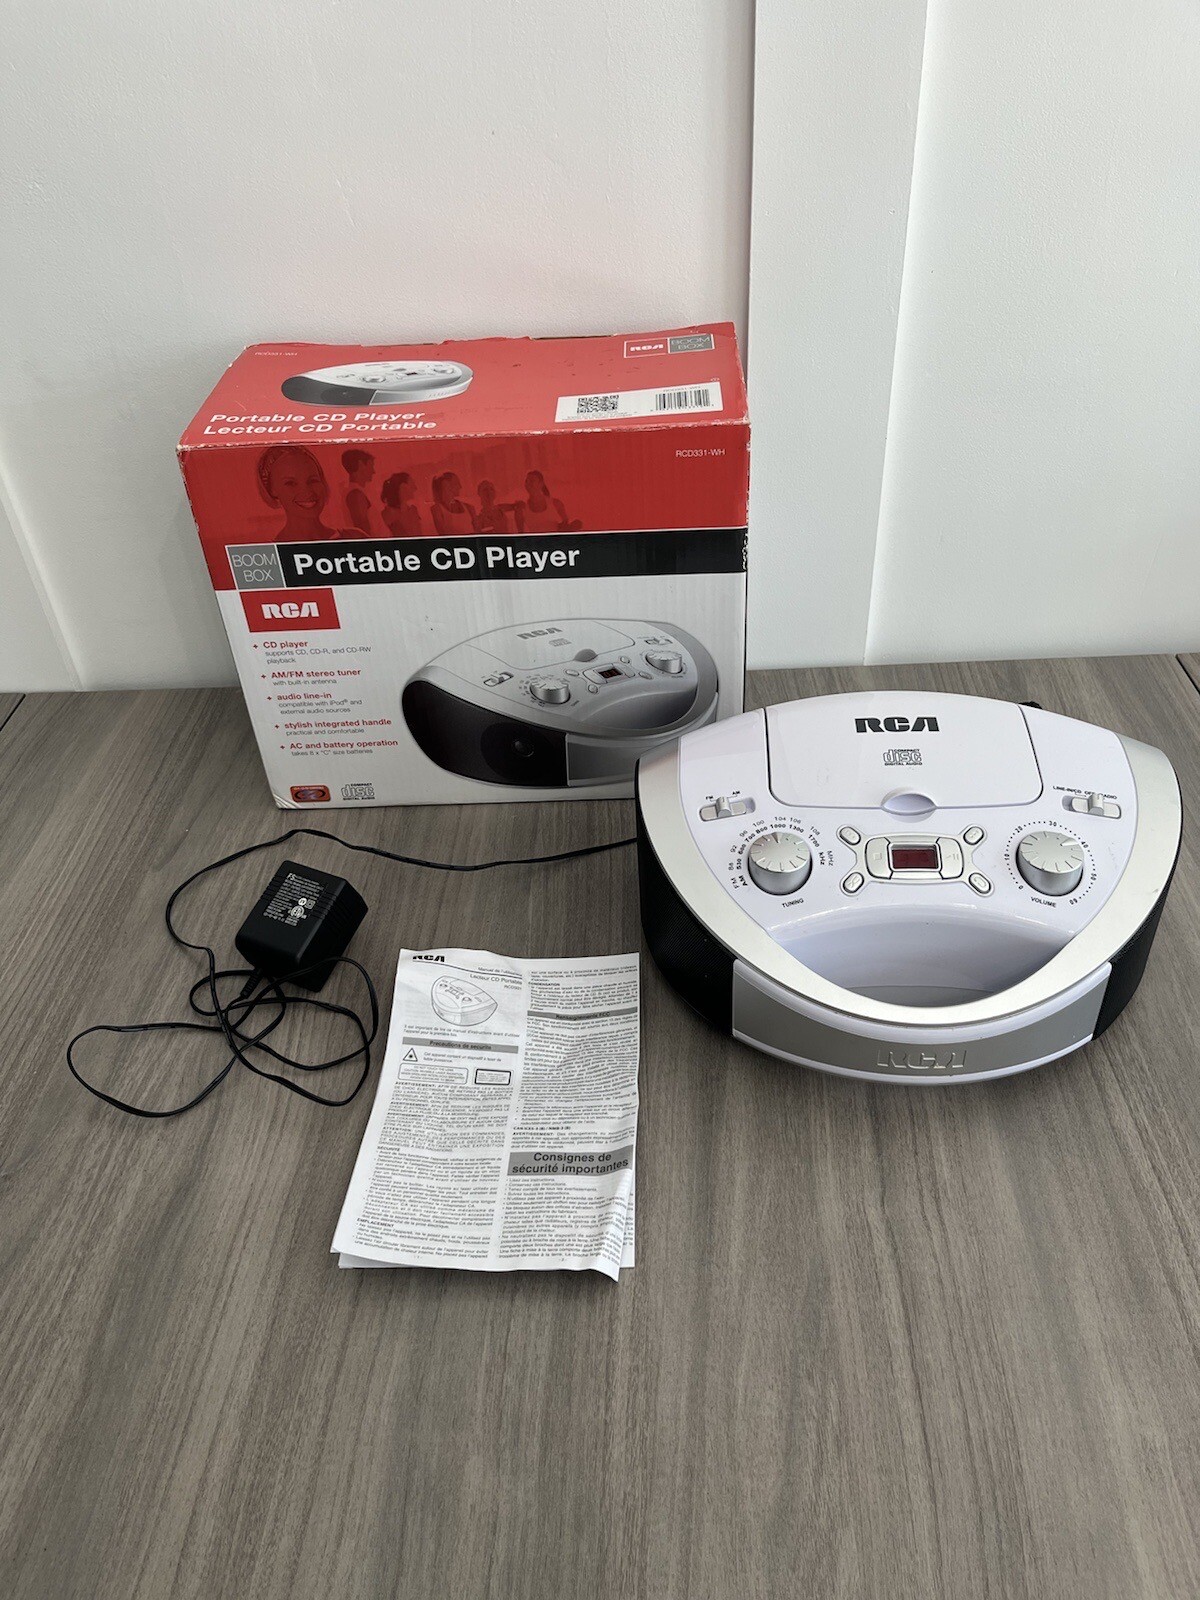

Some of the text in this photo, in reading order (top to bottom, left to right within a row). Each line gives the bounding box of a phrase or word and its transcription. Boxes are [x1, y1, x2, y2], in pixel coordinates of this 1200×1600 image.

[671, 336, 711, 345] BOOM
[210, 412, 426, 423] Portable CD Player
[203, 420, 437, 434] Lecteur CD Portable
[676, 448, 726, 458] RCD331-WH
[232, 552, 277, 568] BOOM
[293, 546, 580, 576] Portable CD Player
[243, 570, 275, 583] BOX
[261, 602, 320, 620] RCA
[517, 627, 563, 640] RCA
[263, 640, 308, 650] CD player
[285, 721, 313, 730] stylish
[315, 720, 360, 728] integrated
[854, 716, 940, 733] RCA
[324, 742, 354, 750] battery
[356, 740, 399, 748] operation
[882, 749, 922, 763] disc
[340, 784, 375, 798] disc
[1081, 840, 1088, 848] 40
[730, 878, 738, 889] FM
[752, 820, 765, 828] 100
[810, 826, 820, 836] 108
[738, 875, 748, 887] AM
[808, 834, 820, 848] 1700
[782, 898, 804, 908] TUNING
[1030, 896, 1056, 908] VOLUME
[412, 955, 445, 963] RCA
[470, 974, 490, 982] Lecteur
[500, 977, 522, 985] Portable
[876, 1049, 966, 1070] RCA
[533, 1152, 612, 1164] Consignes de
[512, 1159, 629, 1175] sécurité importantes
